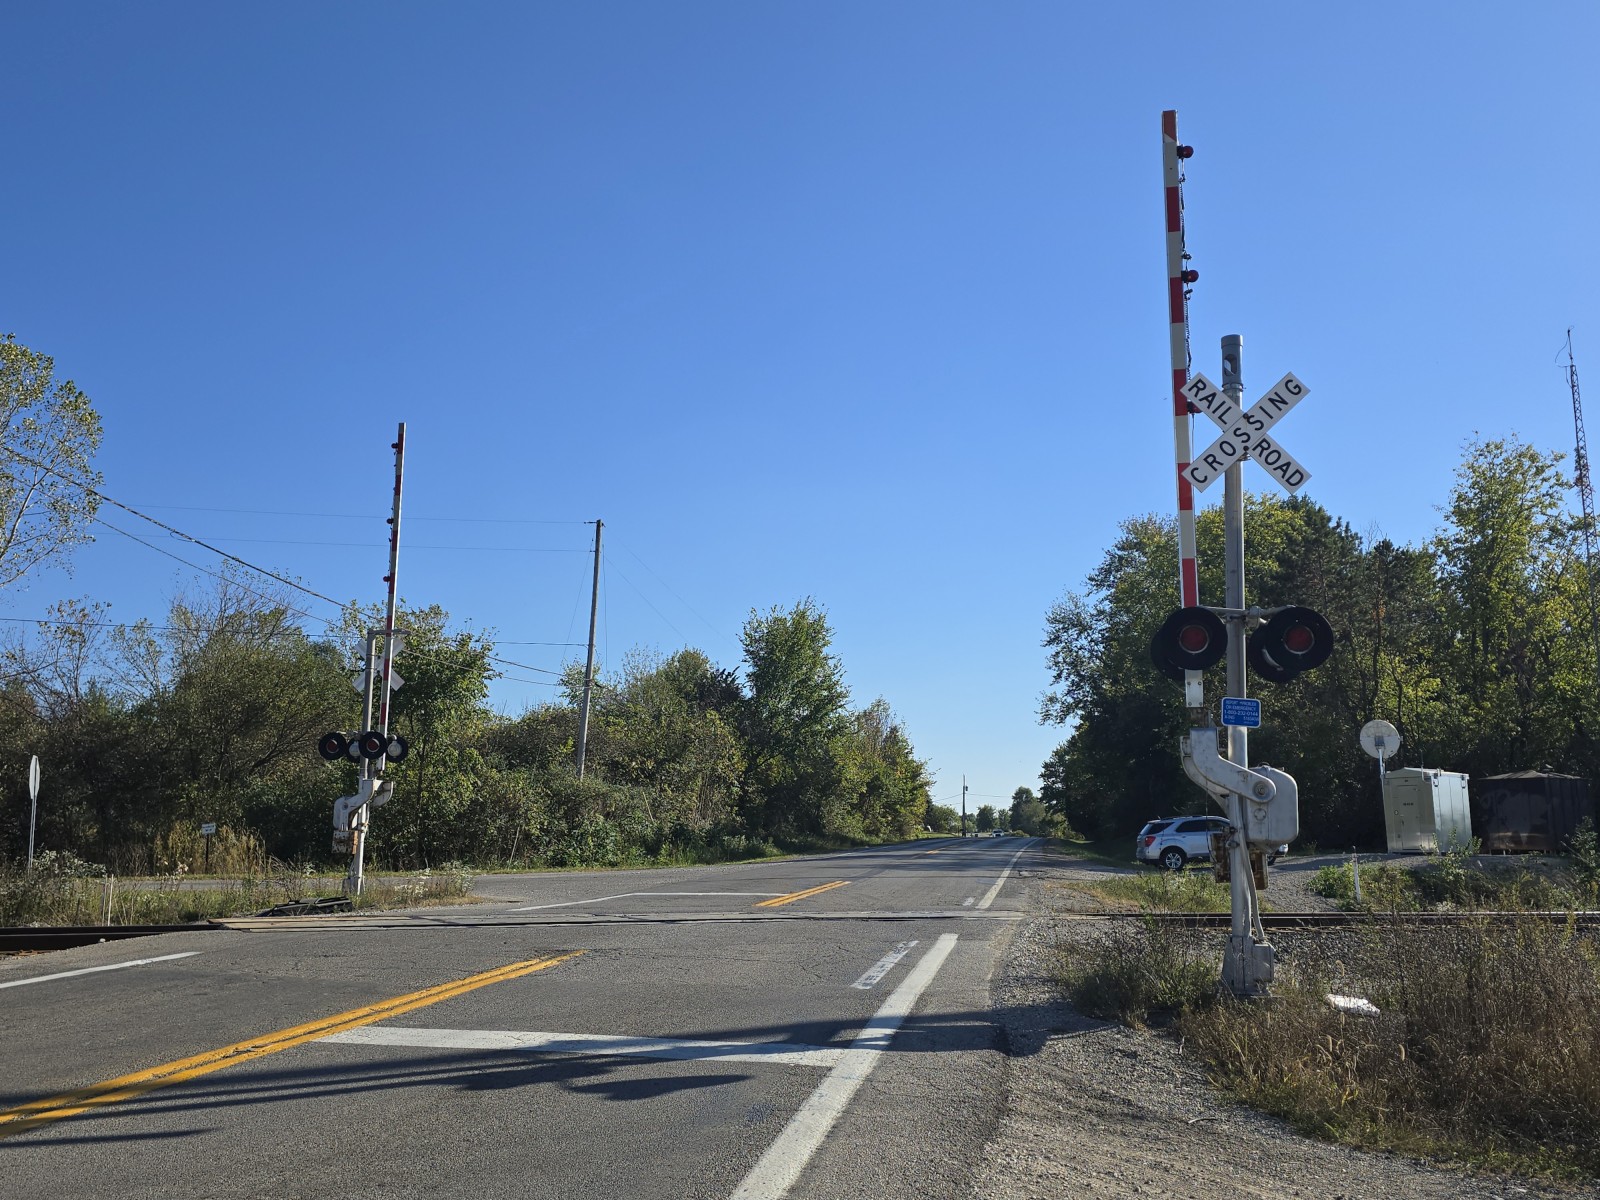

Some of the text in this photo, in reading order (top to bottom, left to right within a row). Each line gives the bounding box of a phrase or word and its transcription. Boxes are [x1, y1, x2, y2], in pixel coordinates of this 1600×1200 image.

[1188, 378, 1304, 487] RAIL ROAD
[1190, 379, 1302, 484] CROSSING
